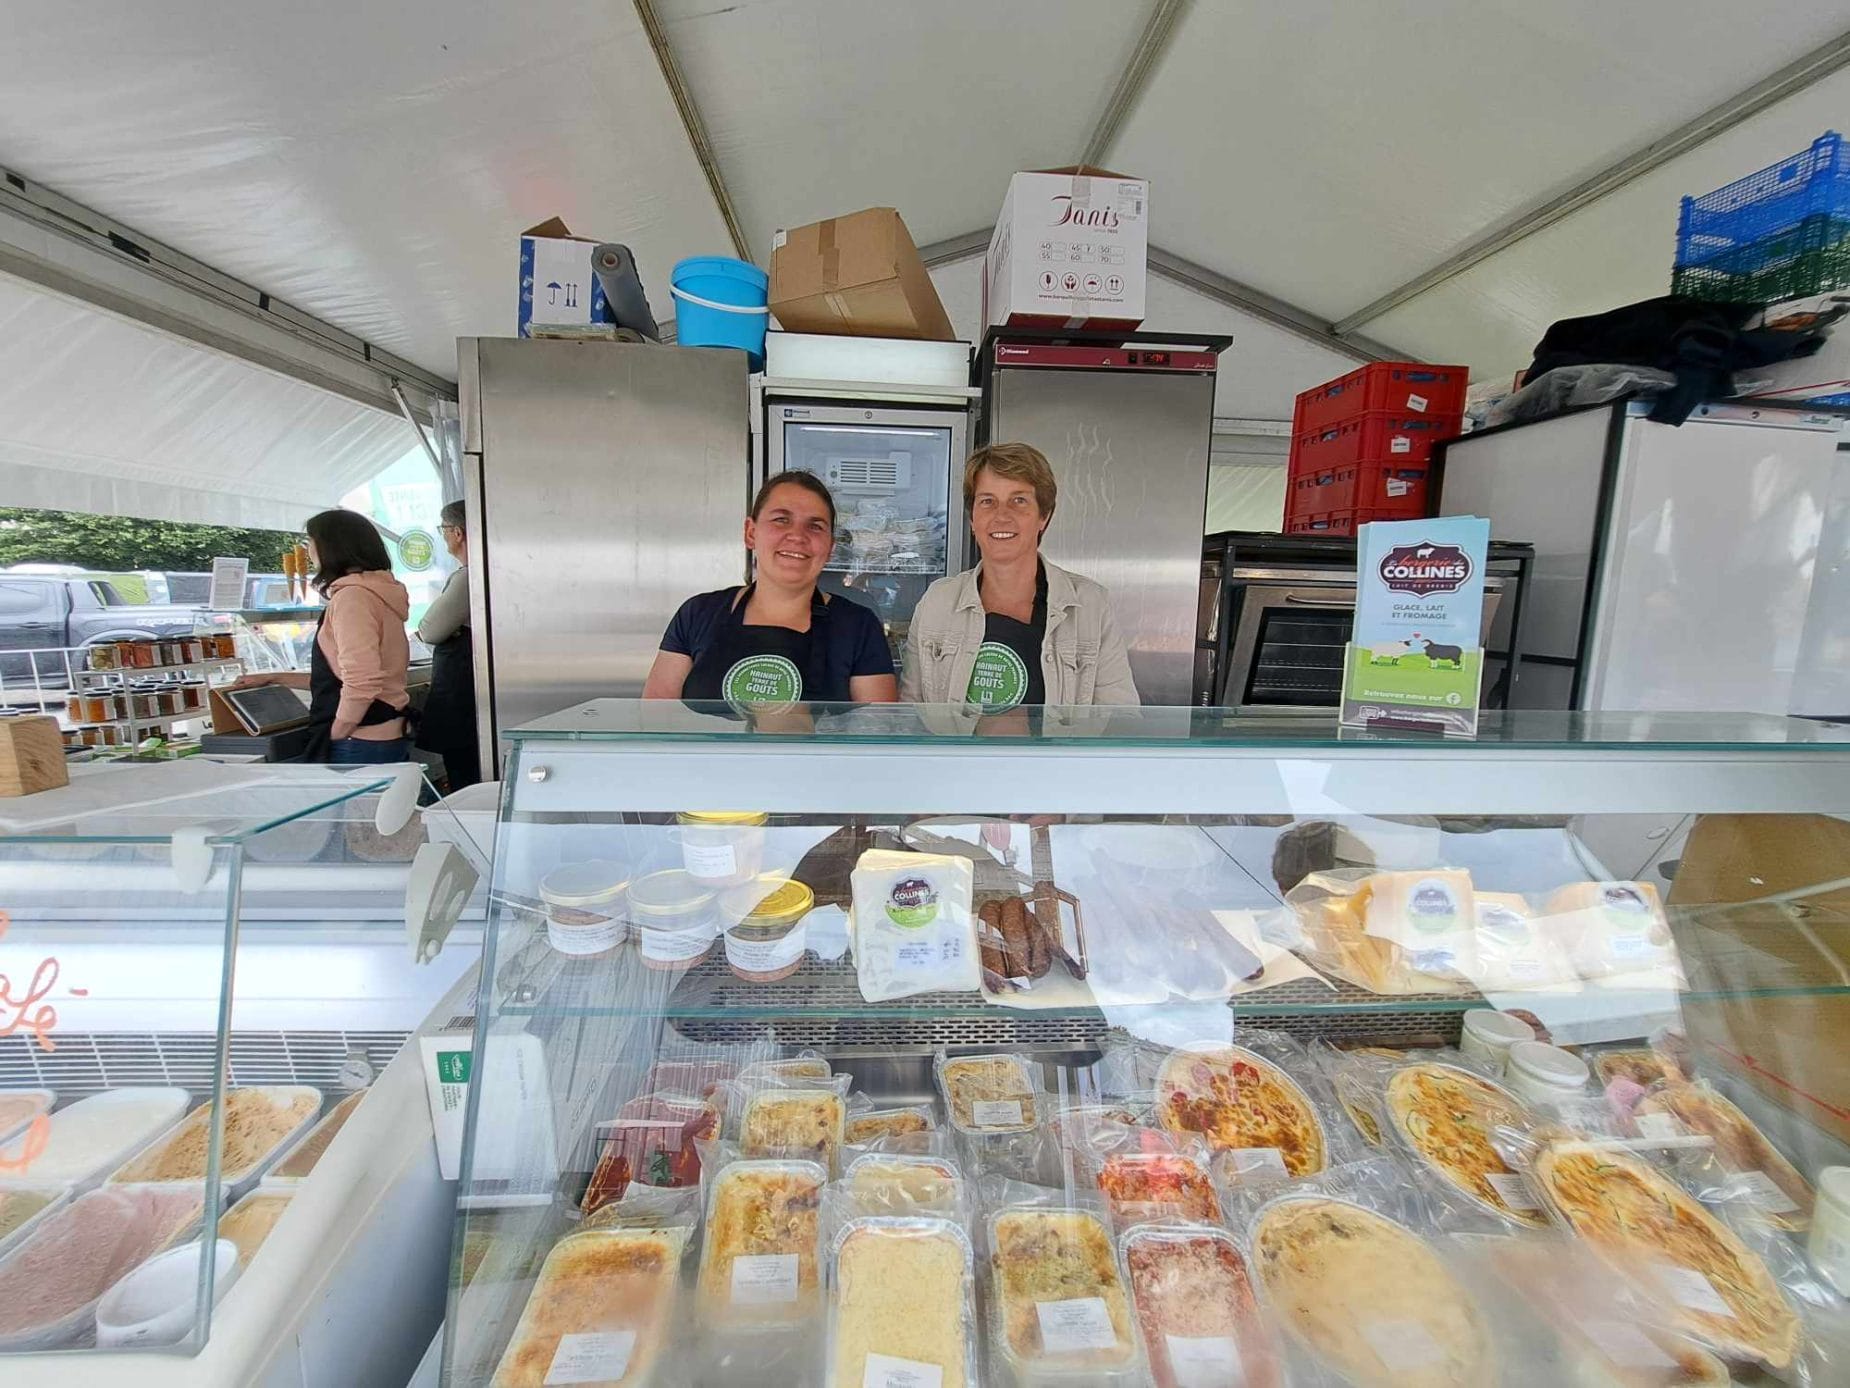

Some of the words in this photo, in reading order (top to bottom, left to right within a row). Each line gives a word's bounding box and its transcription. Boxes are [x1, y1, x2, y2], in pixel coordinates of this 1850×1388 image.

[1383, 566, 1466, 579] COLLINES
[1393, 604, 1423, 612] GLACE,
[1403, 612, 1447, 620] FROMAGE
[750, 670, 782, 681] HAINAUT
